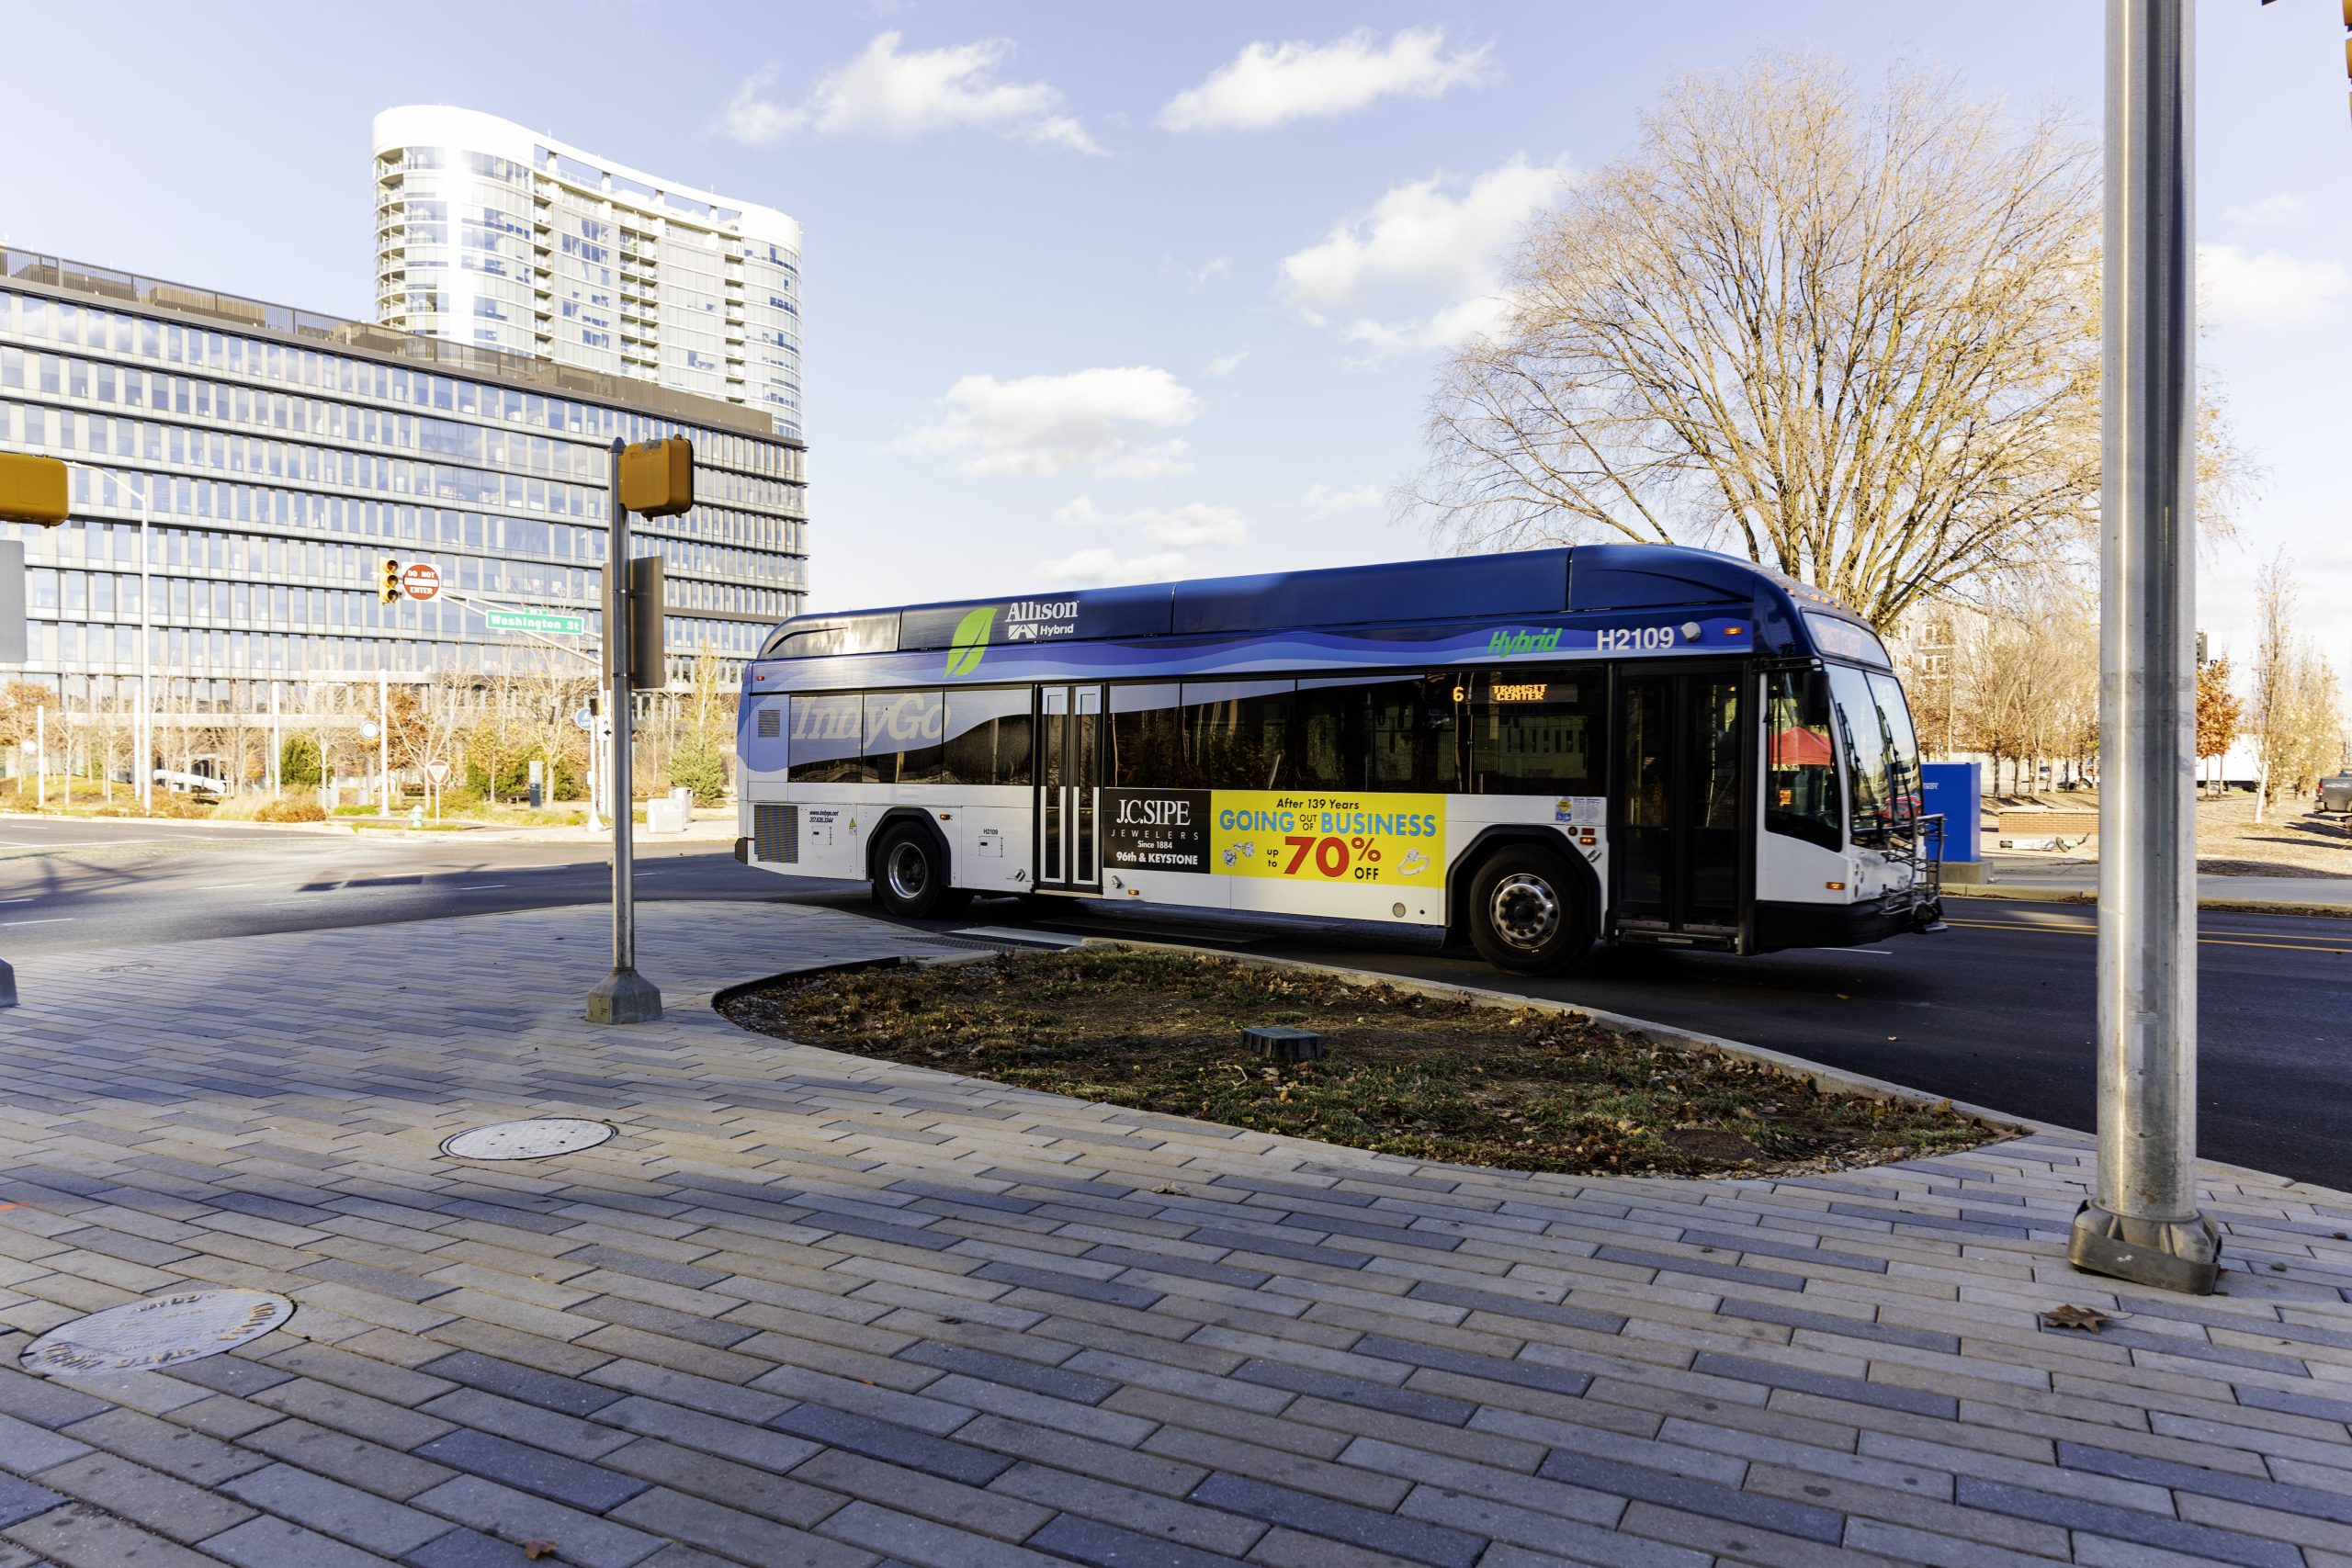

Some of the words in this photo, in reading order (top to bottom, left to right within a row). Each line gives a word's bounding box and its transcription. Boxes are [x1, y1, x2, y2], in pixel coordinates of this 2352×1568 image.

[407, 570, 418, 578] DO
[421, 570, 435, 579] NOT
[410, 586, 434, 594] ENTER
[1004, 600, 1079, 623] Allison
[490, 615, 561, 630] Washington
[566, 619, 580, 631] St
[1040, 624, 1074, 637] Hybrid
[1487, 627, 1563, 659] Hybrid
[1597, 626, 1675, 651] H2109
[1453, 686, 1464, 703] 6
[1491, 683, 1548, 694] TRANSIT
[1496, 692, 1544, 701] CENTER
[790, 692, 952, 750] IndyGo
[1276, 797, 1304, 808] After
[1307, 798, 1327, 809] 139
[1329, 798, 1360, 810] Years
[1219, 809, 1295, 833] GOING
[1299, 814, 1317, 823] OUT
[1321, 812, 1437, 837] BUSINESS
[1302, 822, 1314, 831] OF
[1111, 829, 1199, 840] JEWELERS
[1137, 840, 1155, 849] Since
[1156, 840, 1173, 850] 1884
[1116, 851, 1137, 863] 96th
[1138, 852, 1147, 863] &
[1148, 852, 1198, 865] KEYSTONE
[1266, 849, 1279, 858] up
[1283, 836, 1382, 878] 70%
[1268, 859, 1278, 868] to
[1354, 866, 1379, 880] OFF
